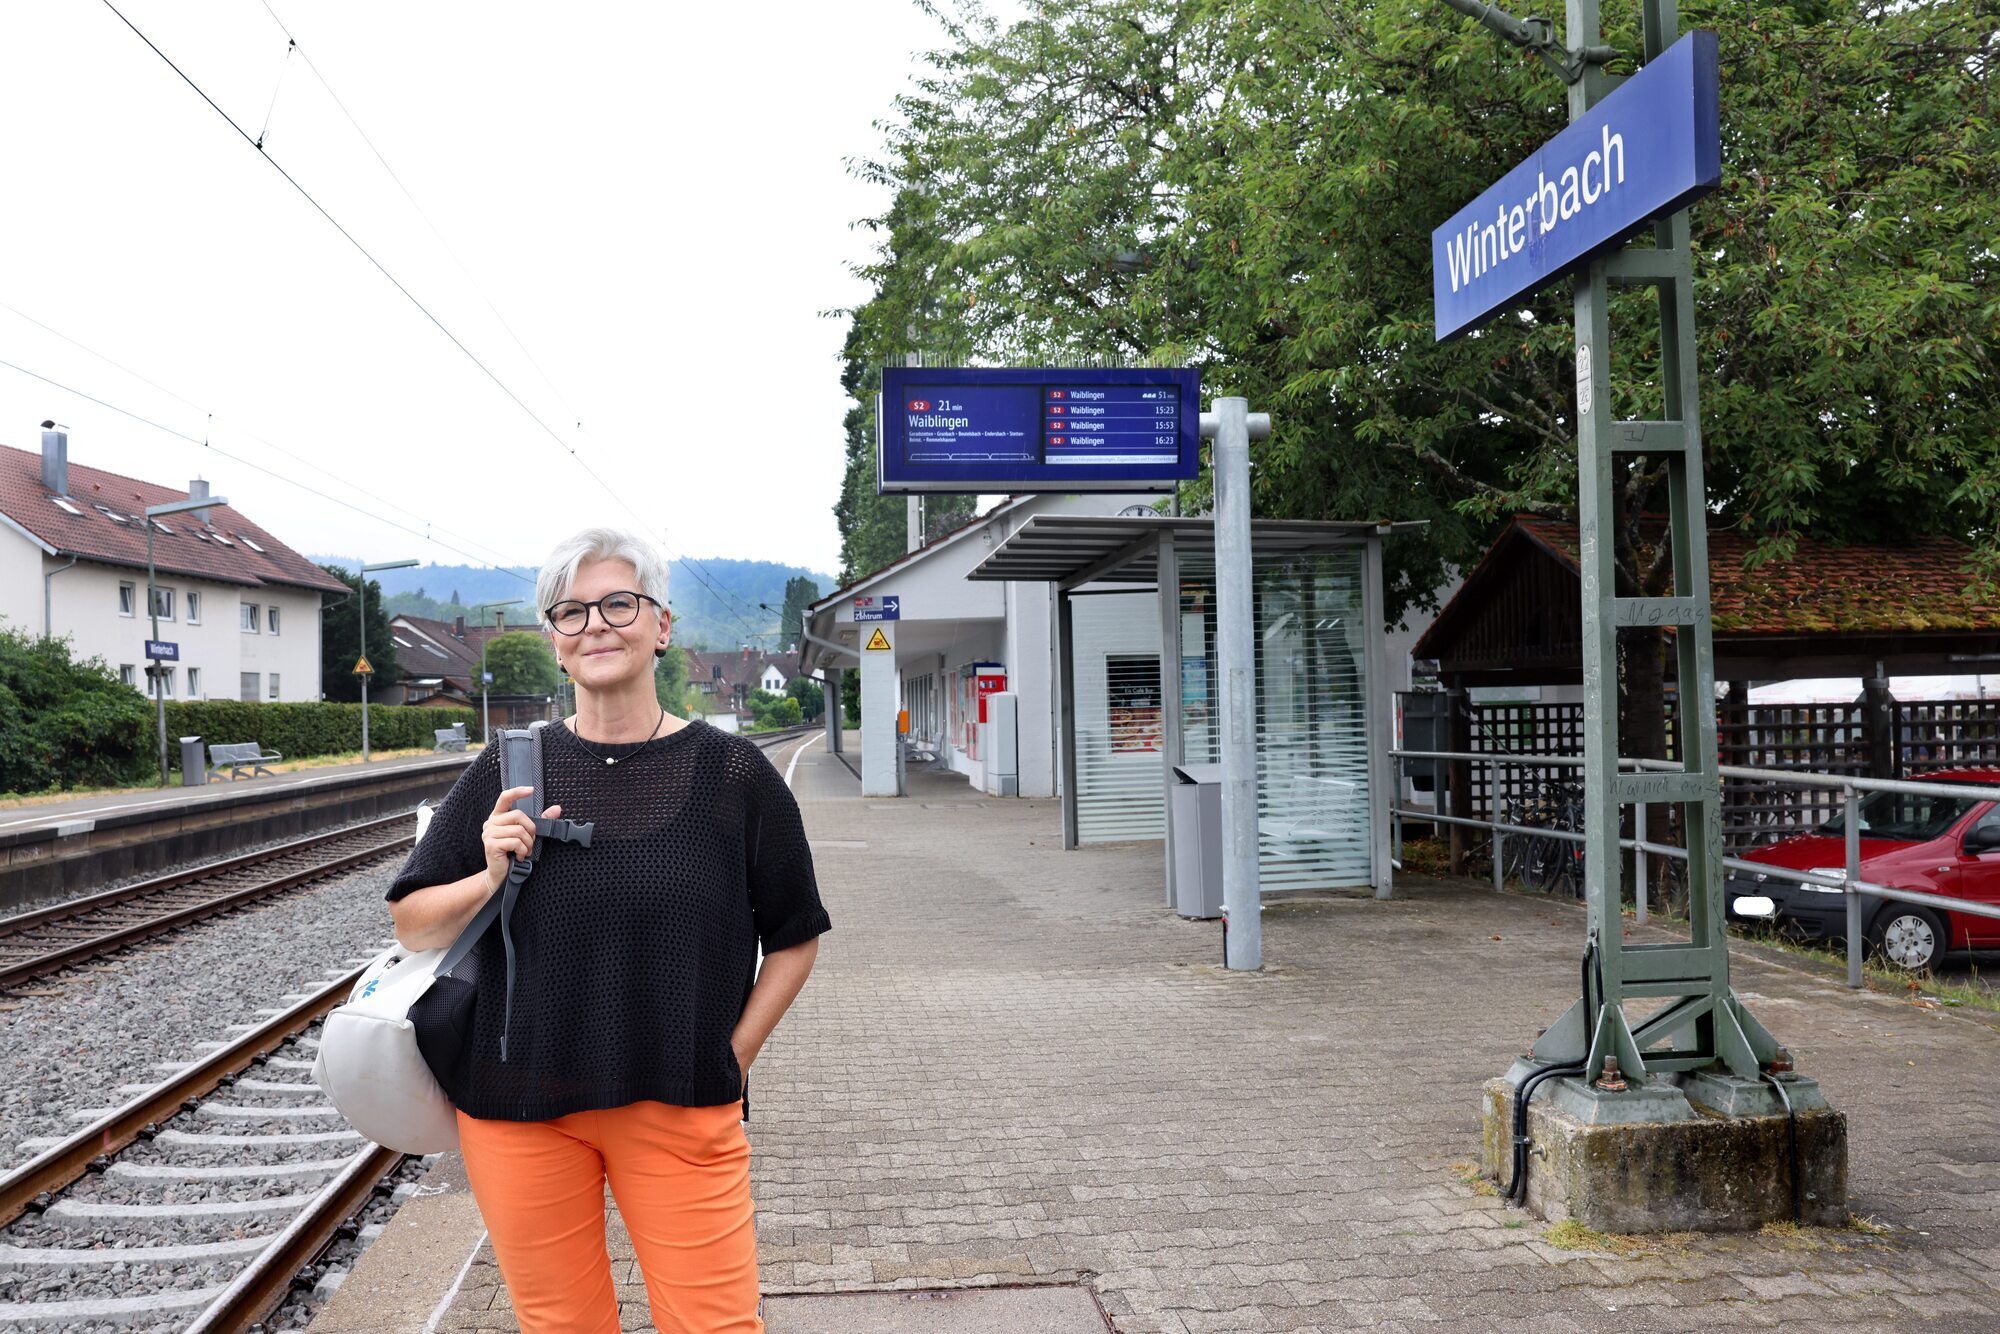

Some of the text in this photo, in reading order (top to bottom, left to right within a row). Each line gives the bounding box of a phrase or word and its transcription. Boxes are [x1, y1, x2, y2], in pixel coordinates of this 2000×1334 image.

[1446, 124, 1625, 293] Winterbach
[1070, 391, 1105, 401] Waiblingen
[1158, 391, 1167, 399] 51
[913, 401, 925, 410] S2
[938, 400, 951, 411] 21
[1070, 406, 1105, 416] Waiblingen
[1155, 406, 1175, 415] 15:23
[908, 415, 969, 430] Waiblingen
[1070, 421, 1105, 431] Waiblingen
[1155, 421, 1175, 430] 15:53
[1070, 437, 1105, 447] Waiblingen
[1155, 436, 1175, 445] 16:23
